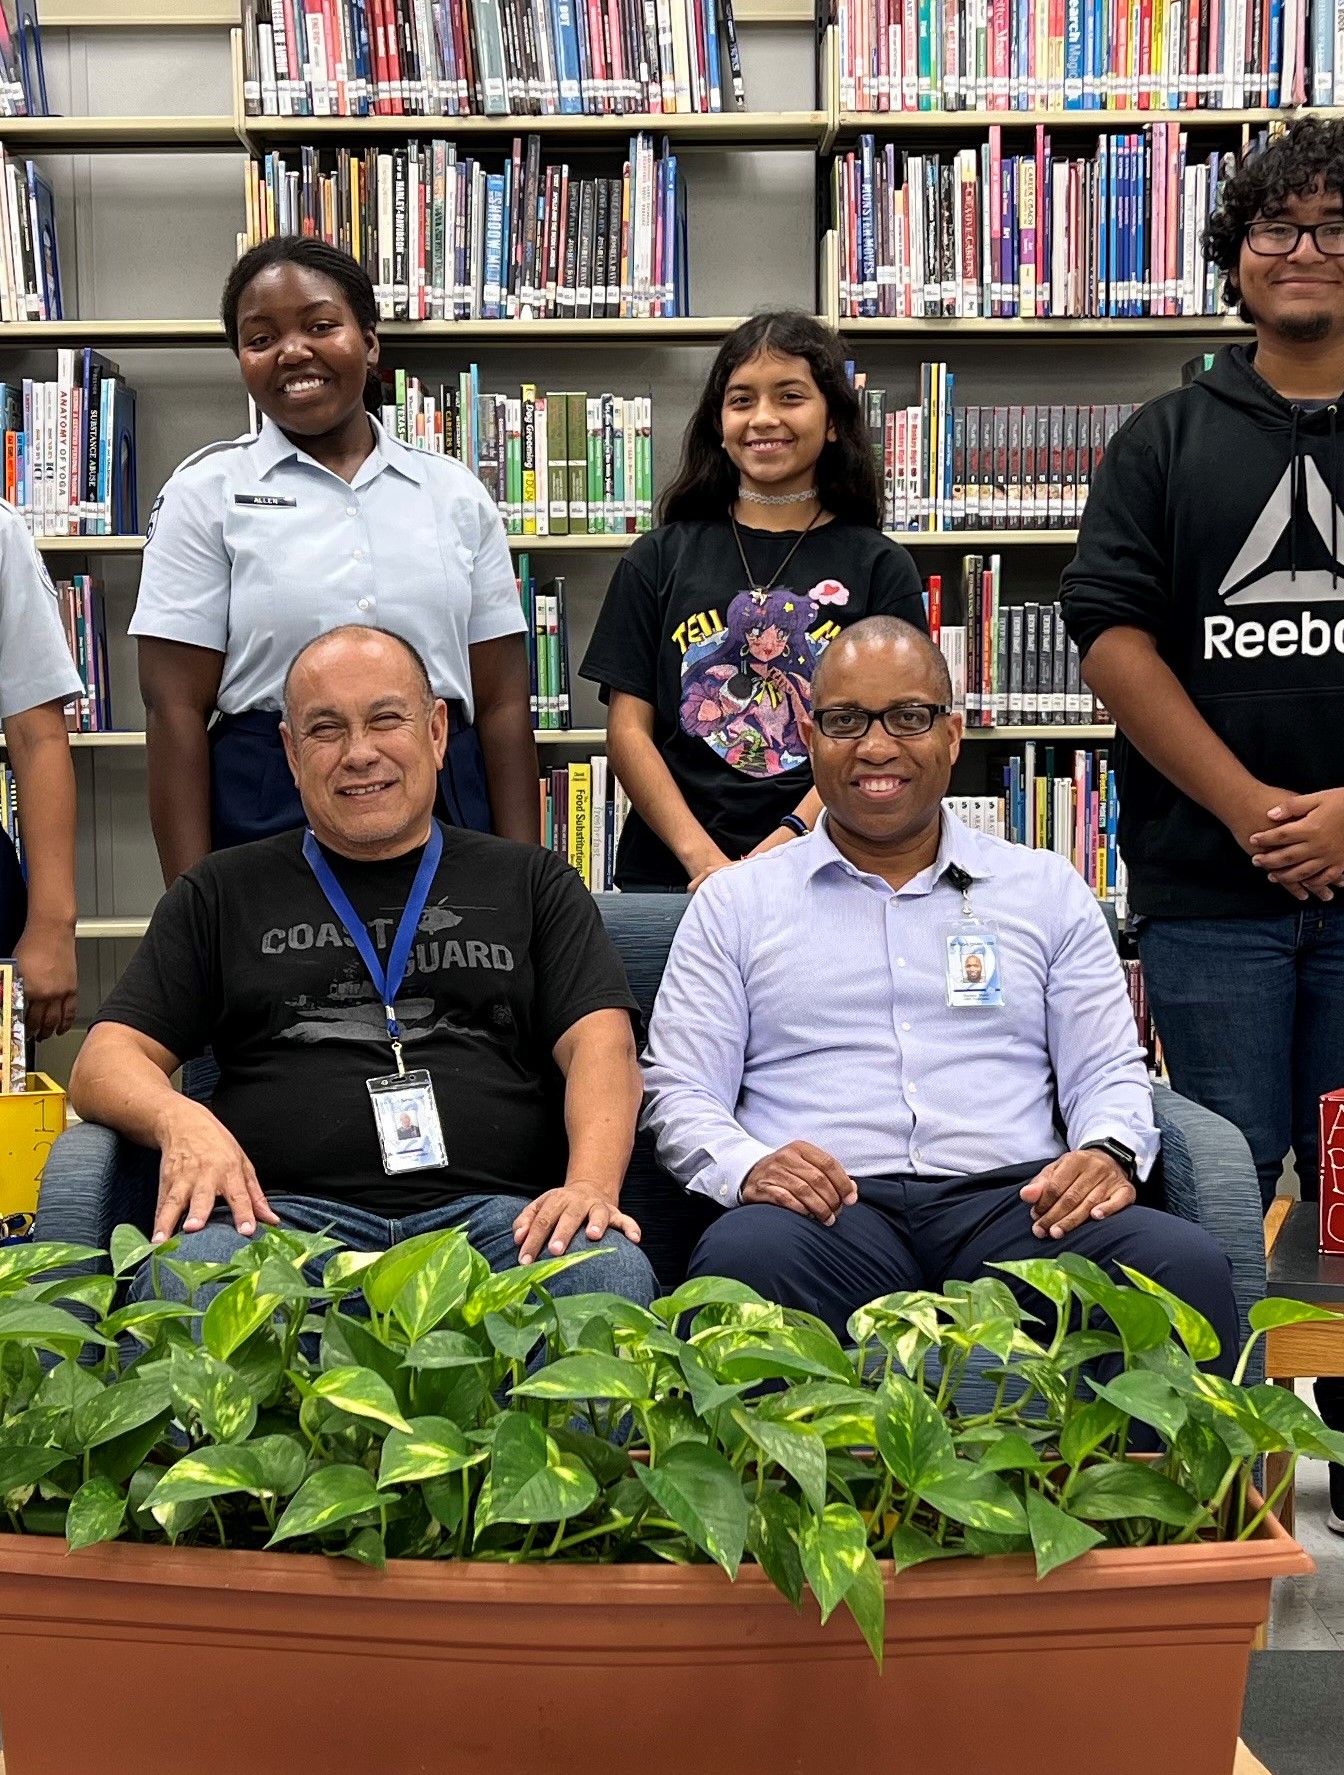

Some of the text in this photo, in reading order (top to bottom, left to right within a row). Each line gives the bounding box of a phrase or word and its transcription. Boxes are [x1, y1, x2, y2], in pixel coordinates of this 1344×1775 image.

[312, 17, 321, 44] ENERGY
[992, 0, 1008, 67] etter Magic
[1067, 0, 1082, 43] earch
[395, 179, 408, 252] HARLEY-DAVIDSON
[862, 184, 874, 237] MONSTER
[863, 239, 875, 274] MOVES
[397, 405, 406, 433] TEXAS
[445, 411, 453, 447] CAREERS
[524, 404, 534, 422] Dog
[59, 391, 68, 496] ANATOMY OF YOGA
[88, 410, 98, 487] SUBSTANCE ABUSE
[524, 425, 534, 468] Grooming
[253, 496, 279, 505] ALLEN
[575, 789, 586, 875] Food Substitutions
[402, 940, 515, 977] GUARD
[34, 1098, 56, 1133] 1
